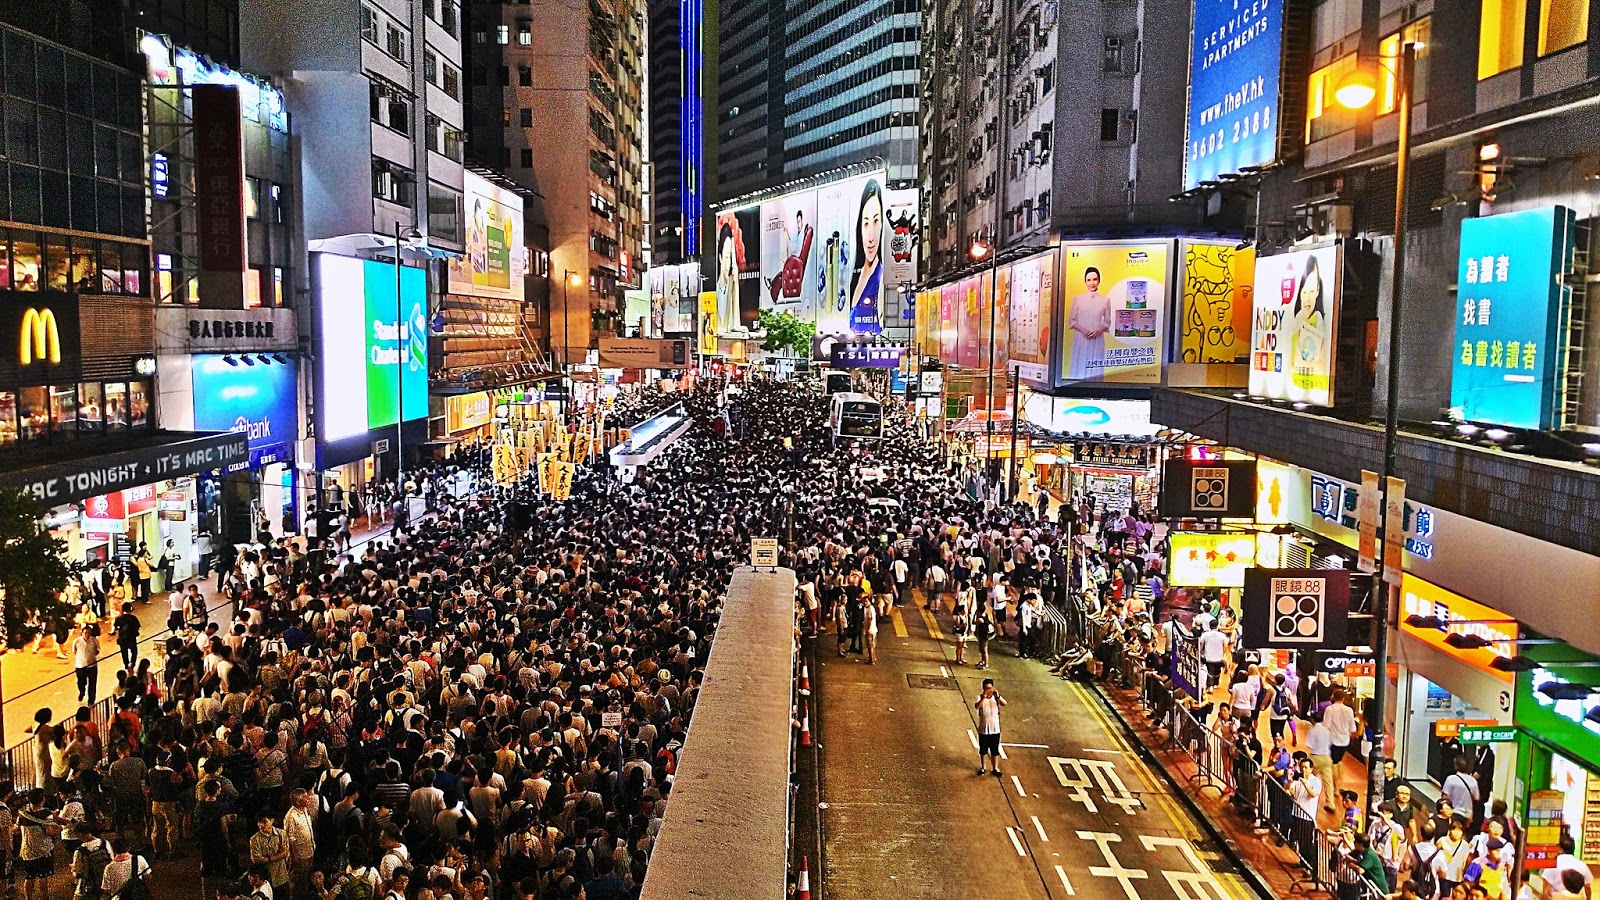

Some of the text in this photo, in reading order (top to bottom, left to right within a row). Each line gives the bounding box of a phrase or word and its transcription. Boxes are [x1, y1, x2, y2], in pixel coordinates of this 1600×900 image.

[1203, 0, 1269, 51] SERVICED
[1202, 17, 1268, 71] APARTMENTS
[1200, 75, 1265, 126] www.theV.hk
[1192, 106, 1271, 161] 3602 2388
[210, 175, 231, 256] 東亞銀行
[1465, 253, 1510, 285] 為讀者
[1463, 298, 1492, 326] 找書
[373, 320, 409, 341] Standrd
[838, 351, 866, 359] TSL
[1461, 340, 1537, 370] 為書找讀者
[156, 454, 181, 475] IT'S
[185, 447, 213, 469] MAC
[217, 441, 245, 461] TIME
[65, 462, 139, 494] TONIGHT
[1275, 580, 1321, 593] 眼鏡88
